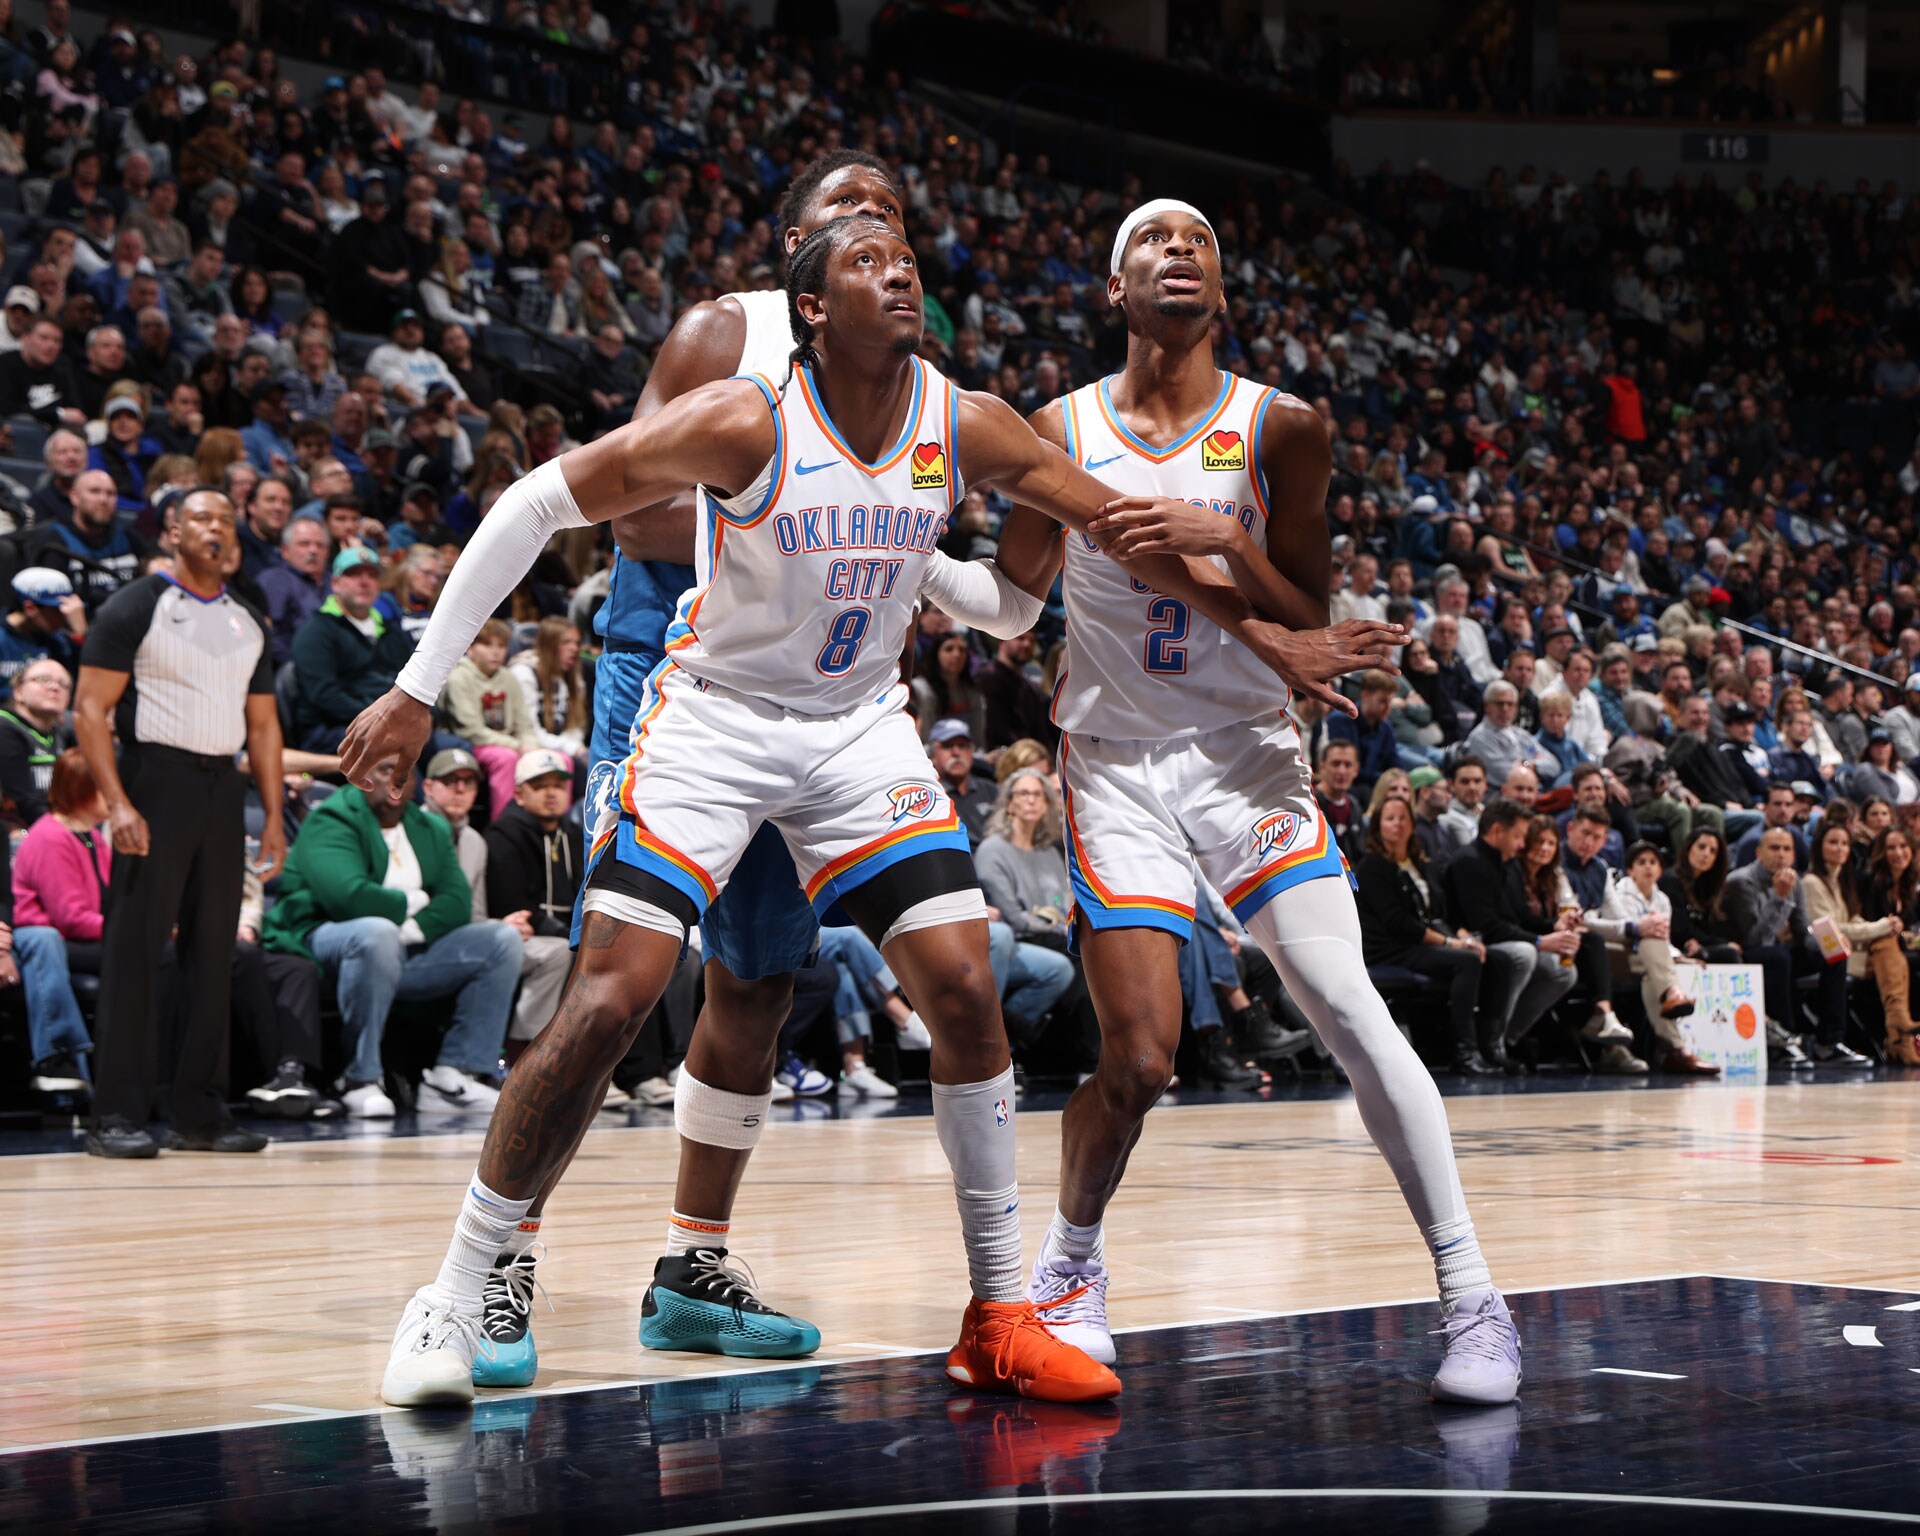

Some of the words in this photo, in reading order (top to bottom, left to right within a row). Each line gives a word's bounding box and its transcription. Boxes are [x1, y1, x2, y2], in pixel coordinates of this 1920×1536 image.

[1704, 136, 1748, 160] 116
[773, 504, 947, 556] OKLAHOMA
[825, 558, 904, 601] CITY
[816, 607, 871, 678] 8
[1144, 594, 1190, 675] 2
[893, 789, 928, 821] OKC
[1259, 815, 1291, 855] OKC
